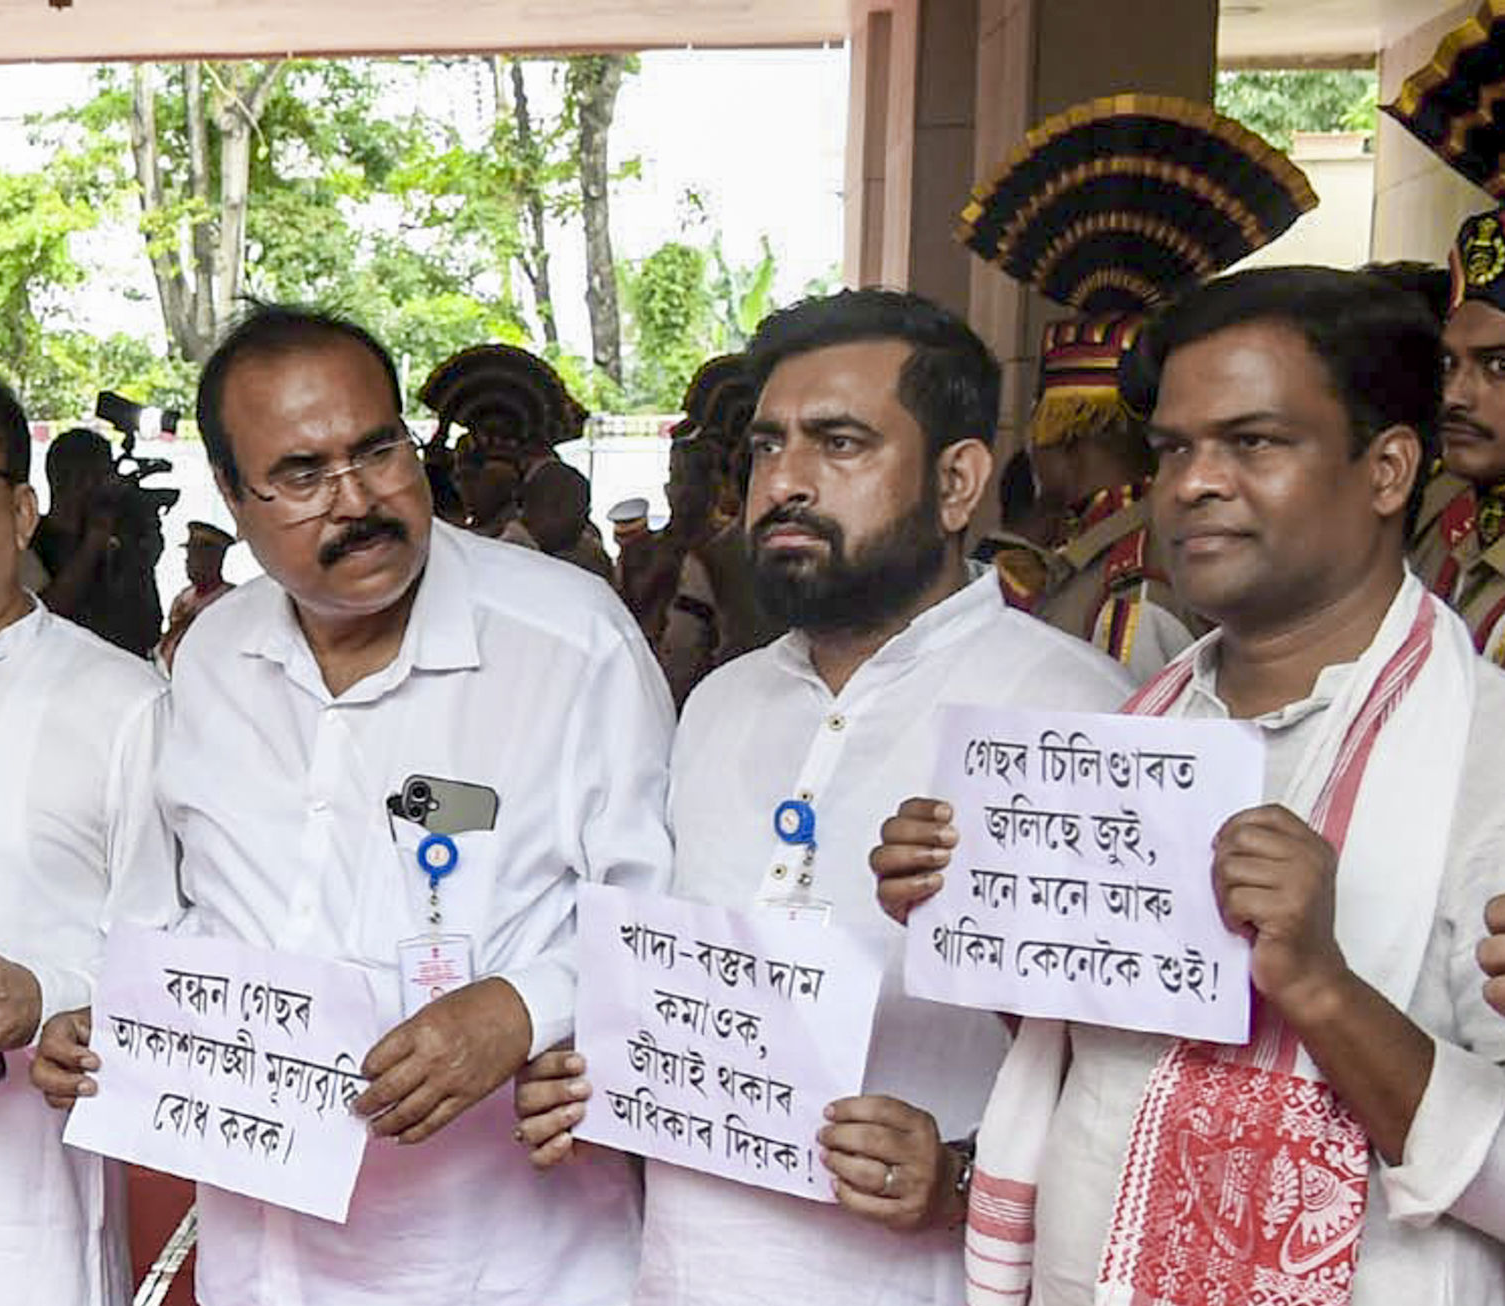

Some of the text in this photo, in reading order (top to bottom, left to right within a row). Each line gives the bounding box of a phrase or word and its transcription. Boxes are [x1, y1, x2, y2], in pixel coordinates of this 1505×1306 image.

[965, 730, 1196, 789] গেছৰ চিলিণ্ডাৰত
[984, 793, 1156, 866] জ্বলিছে জুই,
[970, 869, 1172, 922] মনে মনে আৰু
[620, 923, 825, 1000] খাদ্য-বস্তুৰ দাম
[933, 916, 1005, 970] থাকিম
[1016, 938, 1143, 986] কেনেকৈ
[164, 969, 313, 1036] ৰন্ধন গেছৰ
[654, 989, 767, 1059] কমাওক,
[627, 1030, 794, 1115] জীয়াই থকাৰ
[154, 1093, 210, 1138] ৰোধ
[605, 1087, 713, 1150] অধিকাৰ
